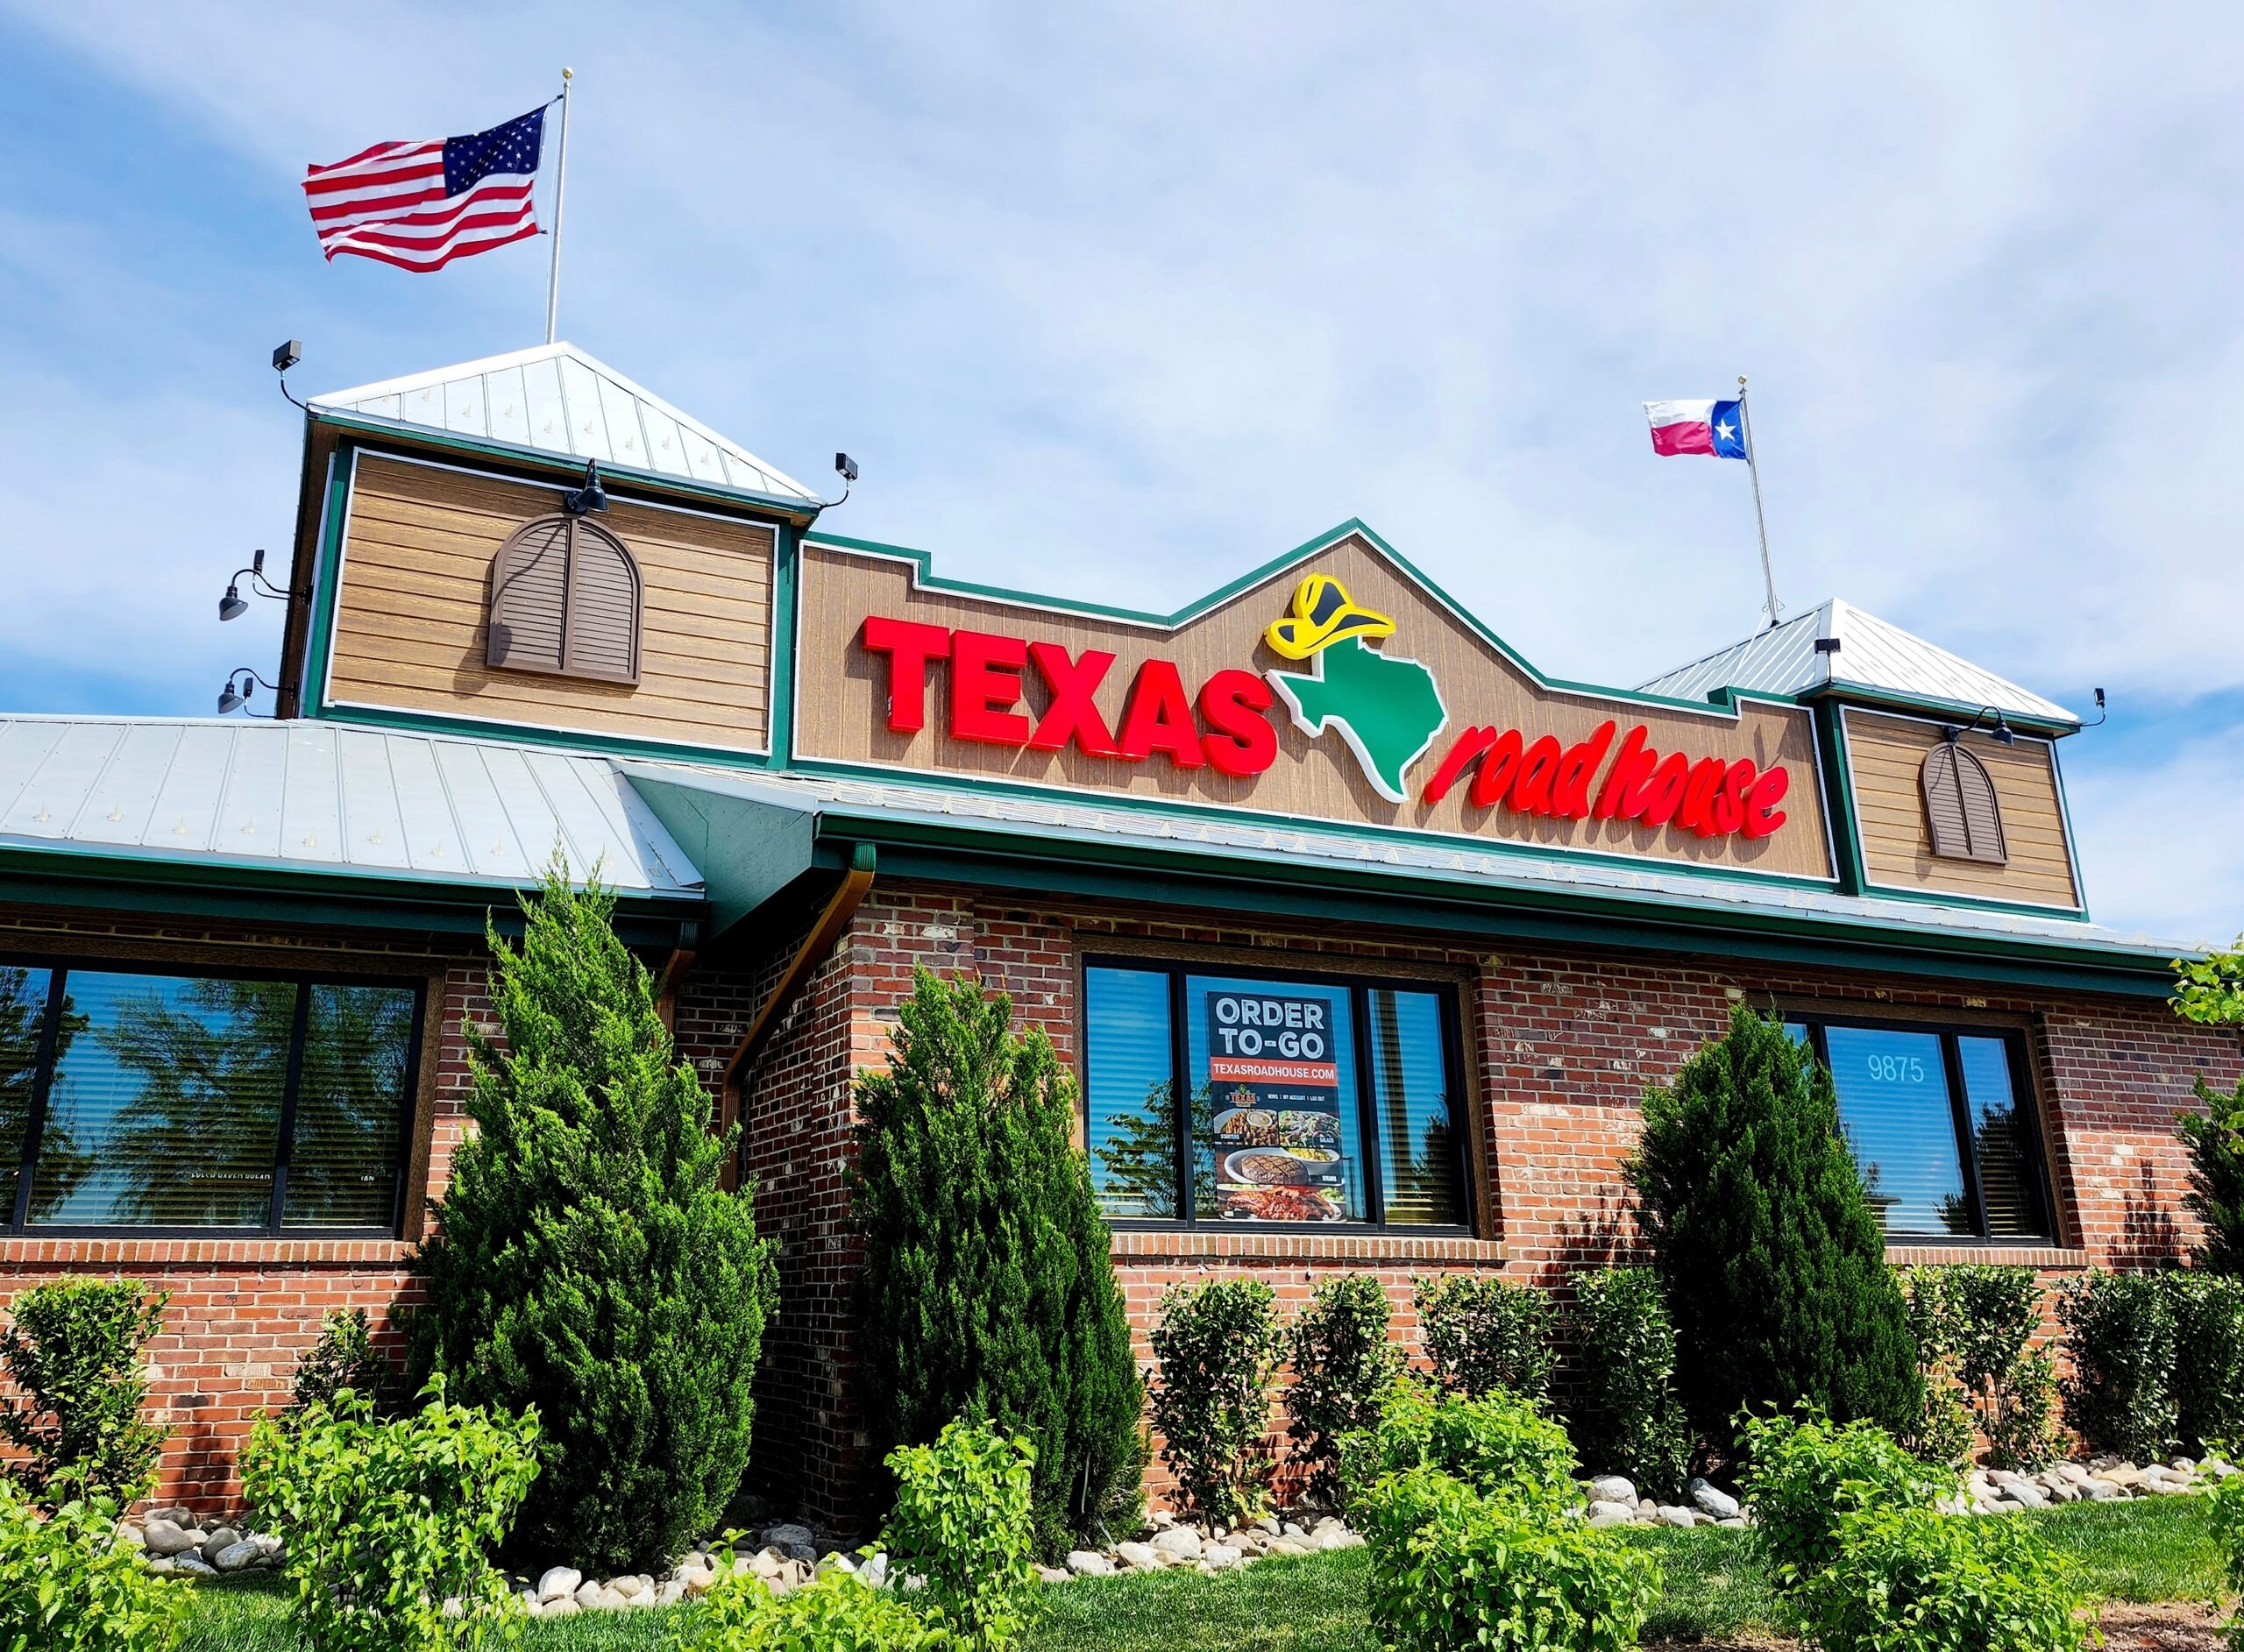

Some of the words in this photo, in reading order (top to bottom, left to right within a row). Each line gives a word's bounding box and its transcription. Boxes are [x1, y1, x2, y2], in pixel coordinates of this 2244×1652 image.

[863, 615, 1278, 778] TEXAS
[1215, 997, 1325, 1030] ORDER
[1218, 1027, 1324, 1060] TO-GO
[1213, 1063, 1334, 1080] TEXASROADHOUSE.COM
[1867, 1054, 1925, 1083] 9875
[1229, 1092, 1257, 1103] TEXAS
